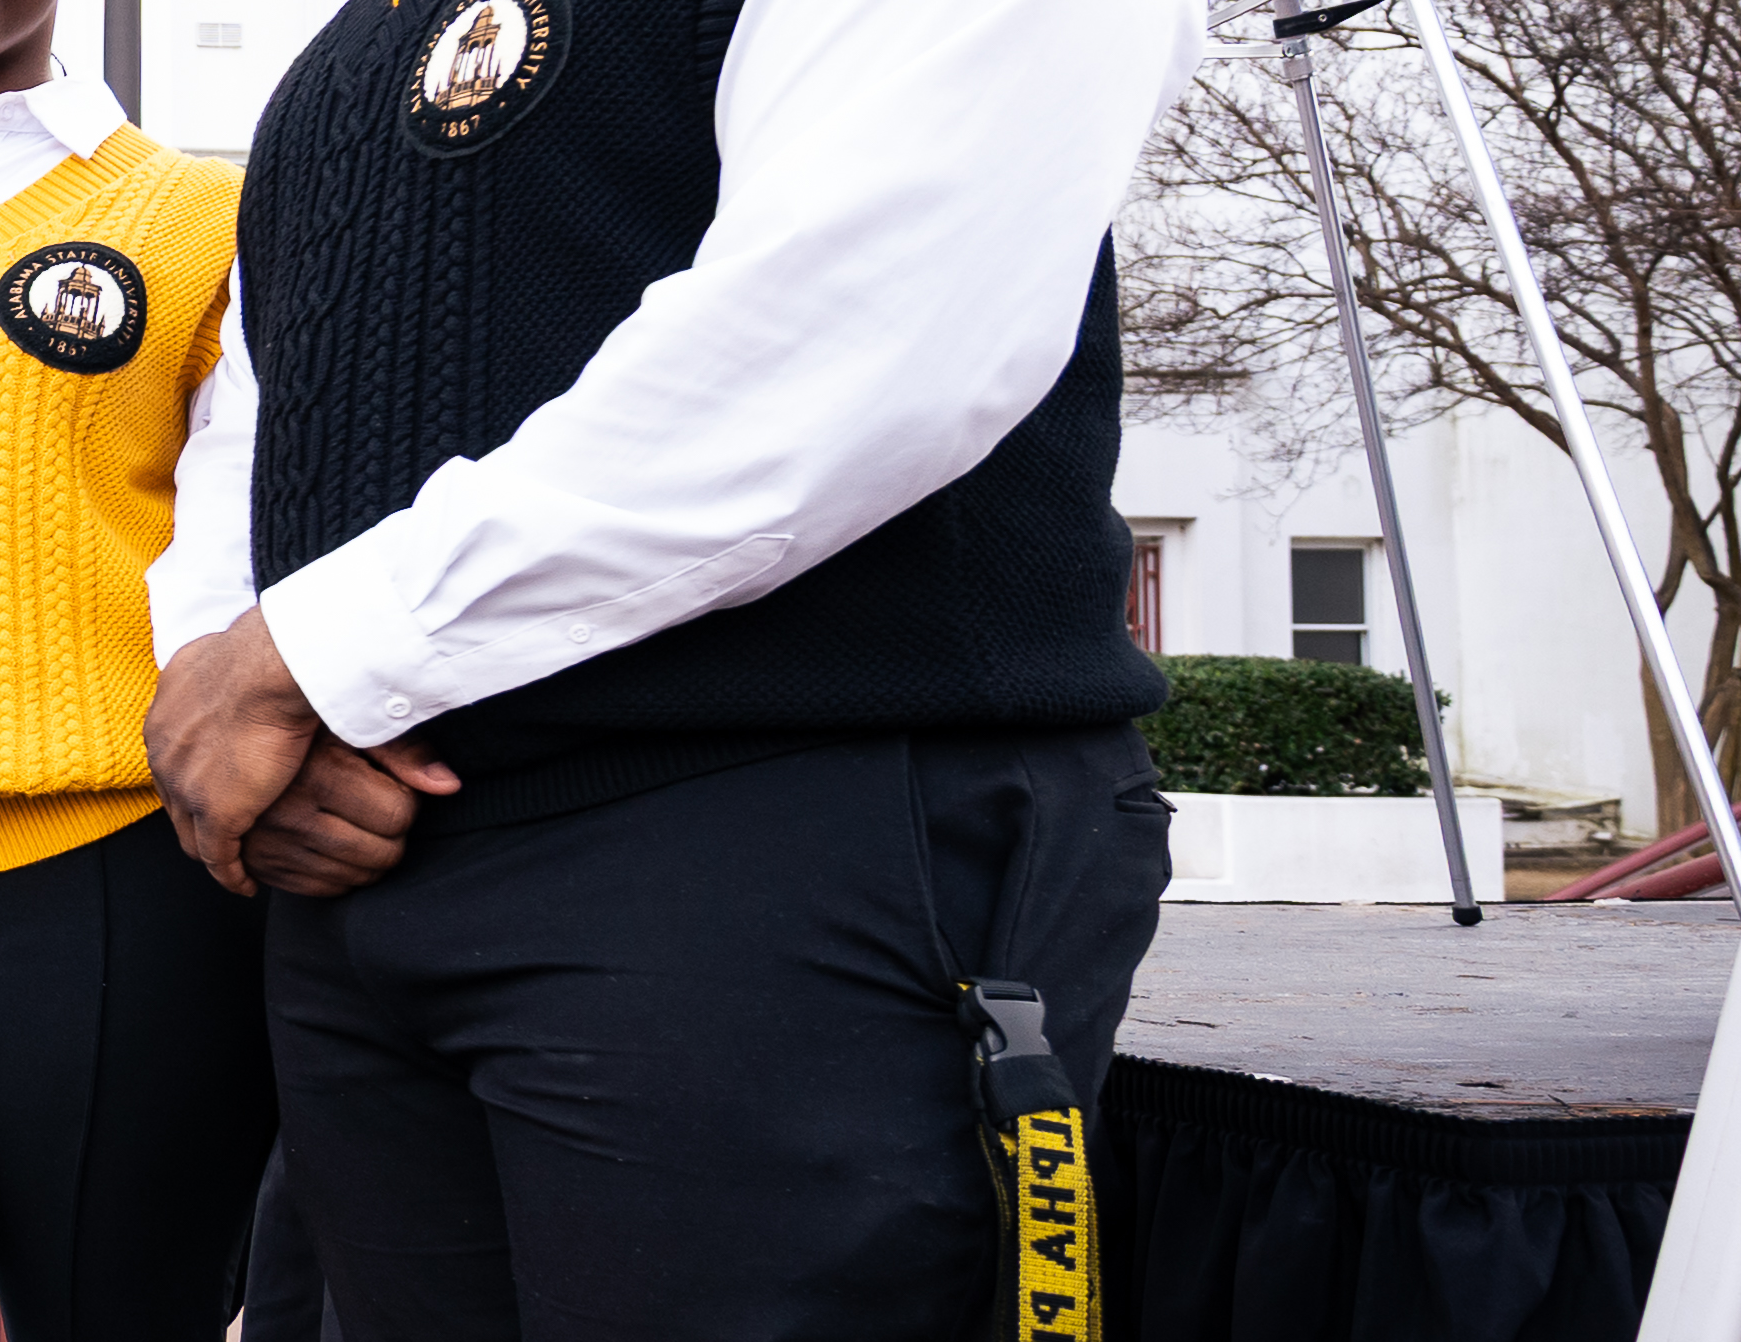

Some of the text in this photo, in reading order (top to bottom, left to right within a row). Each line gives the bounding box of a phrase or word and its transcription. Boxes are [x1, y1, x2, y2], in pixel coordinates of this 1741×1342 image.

[441, 113, 481, 139] 1867
[8, 262, 43, 320] ALABAMA
[45, 250, 99, 263] STATE
[47, 337, 88, 357] 1867
